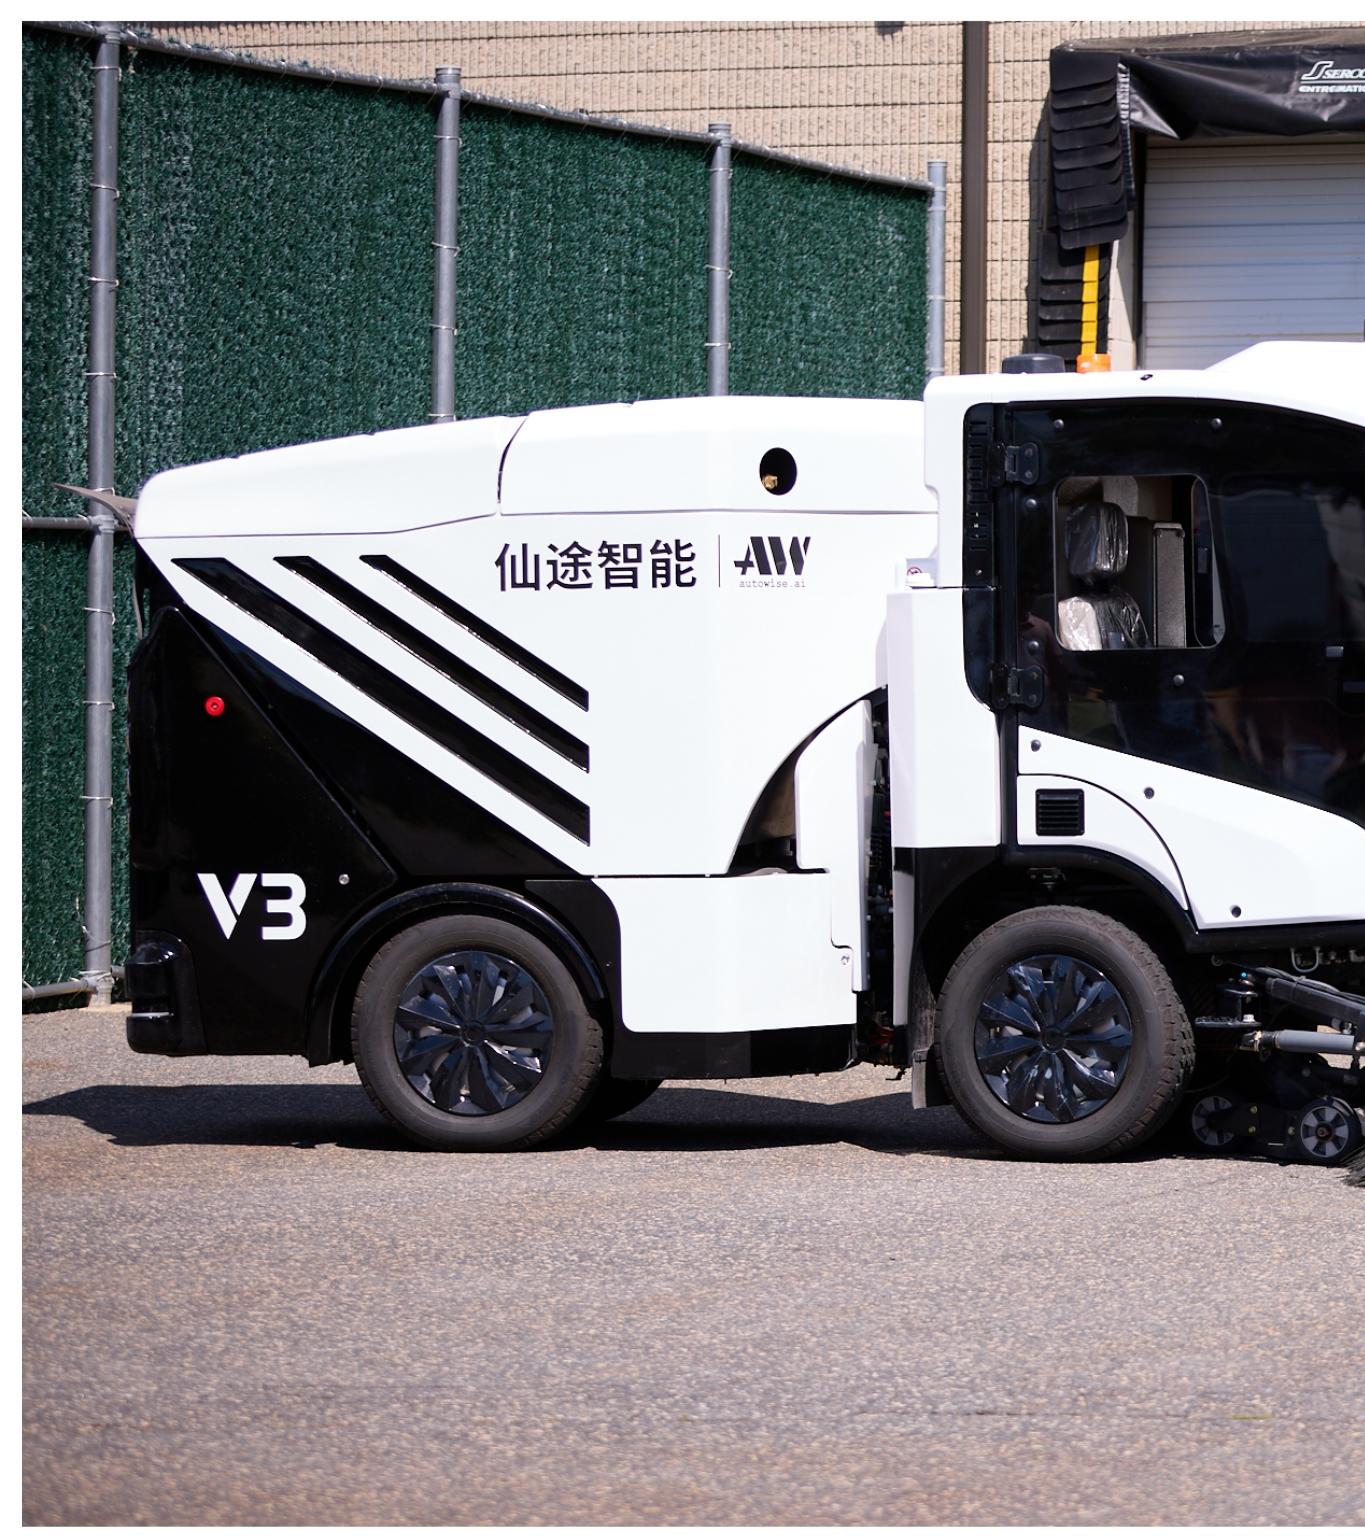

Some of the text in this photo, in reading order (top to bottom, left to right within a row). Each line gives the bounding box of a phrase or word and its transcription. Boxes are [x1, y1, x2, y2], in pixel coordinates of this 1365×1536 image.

[494, 536, 811, 592] 仙途智能 AW
[738, 577, 807, 588] autowise.ai
[197, 872, 307, 941] V3
